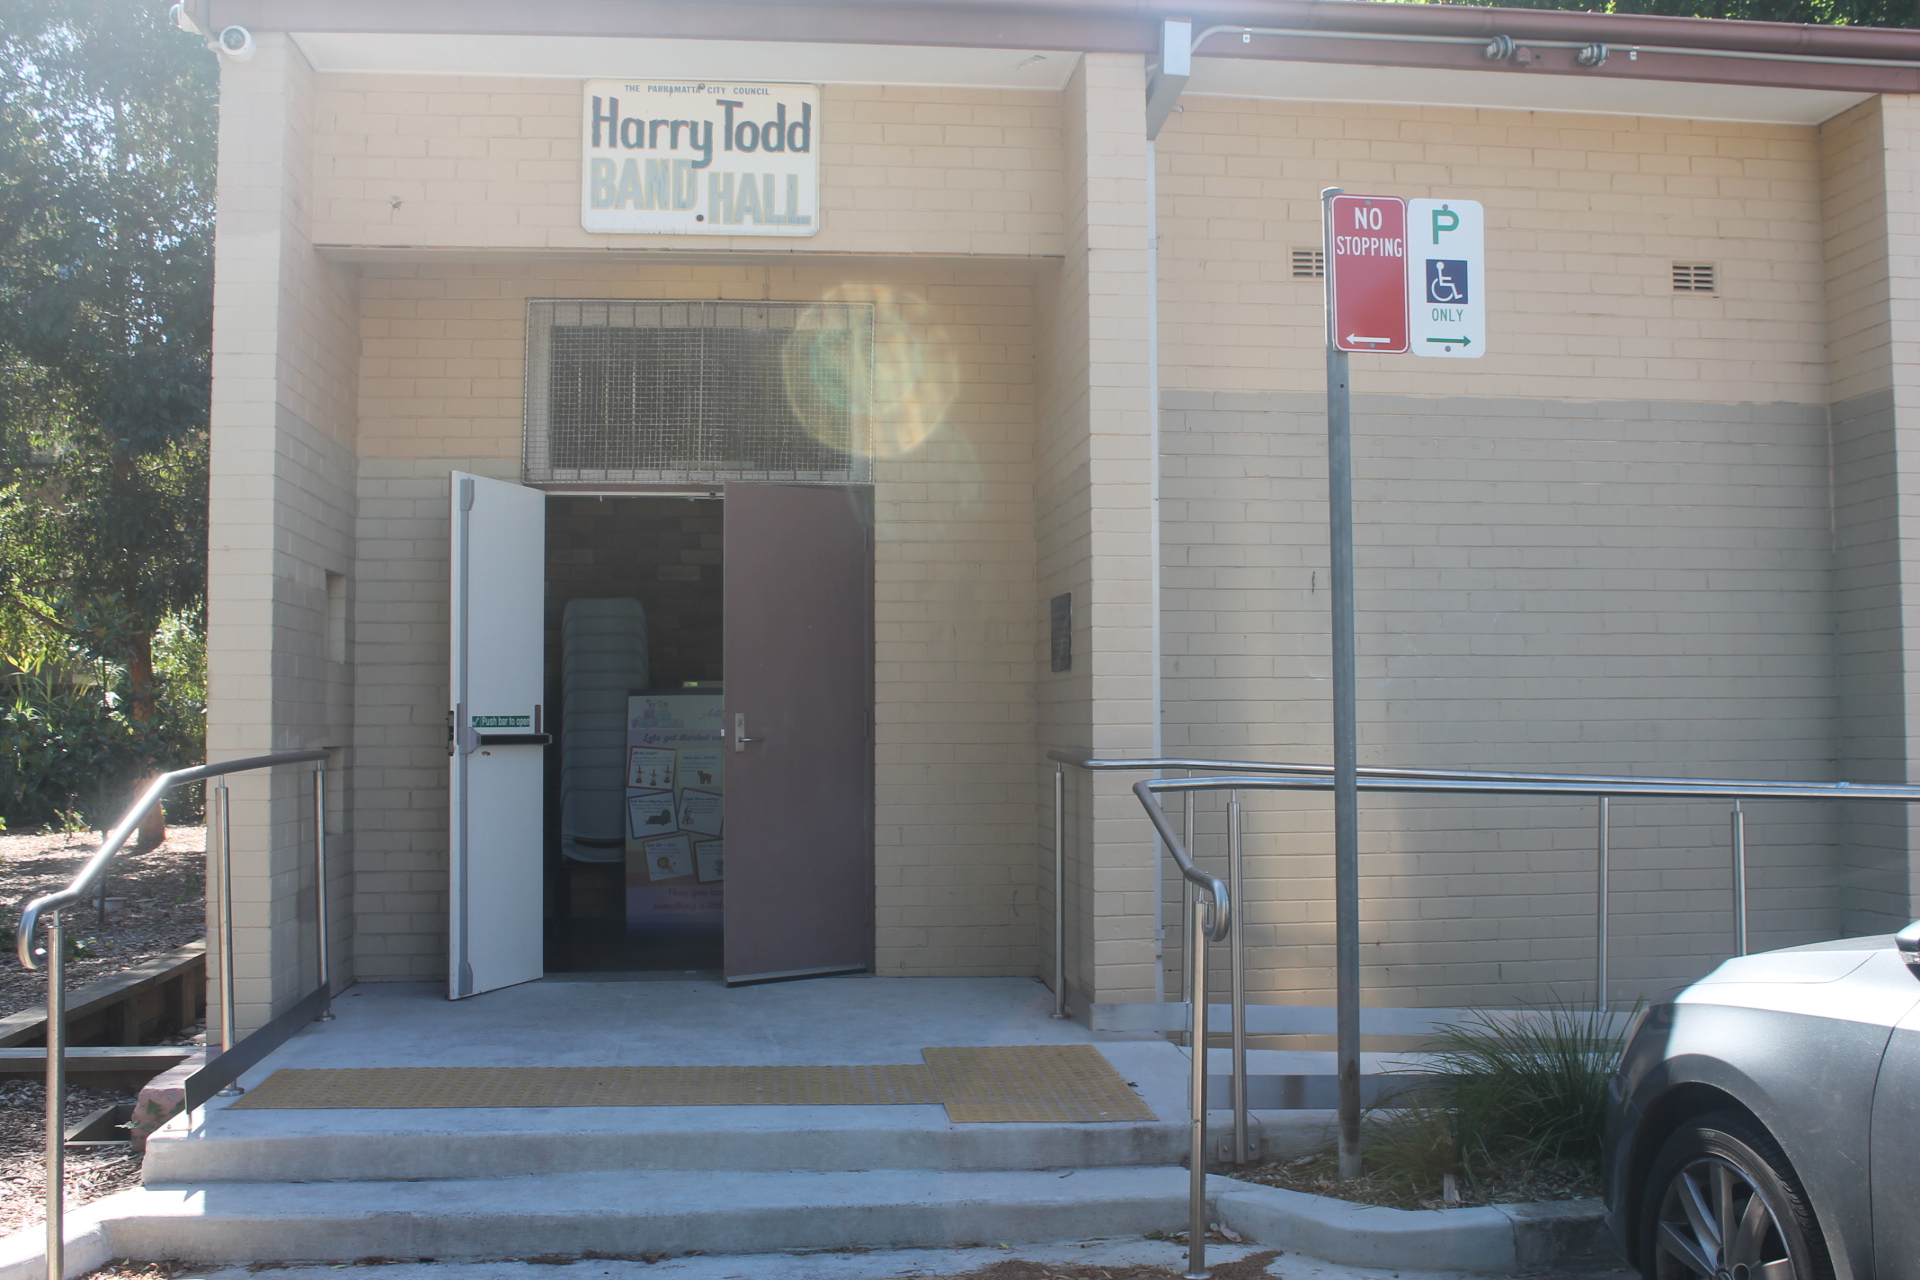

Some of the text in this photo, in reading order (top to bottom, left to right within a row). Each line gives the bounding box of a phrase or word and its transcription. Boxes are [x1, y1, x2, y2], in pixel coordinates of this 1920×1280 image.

[624, 84, 770, 96] THE PARRAMATTA CITY COUNCIL
[591, 95, 812, 170] Harry Todd
[590, 156, 699, 211] BAND
[707, 171, 812, 227] HALL
[1354, 207, 1383, 231] NO
[1432, 209, 1460, 245] P
[1336, 235, 1403, 258] STOPPING
[1431, 307, 1464, 323] ONLY
[481, 717, 497, 726] Push
[498, 717, 508, 726] bar
[509, 717, 515, 726] to
[663, 733, 677, 744] get
[691, 889, 708, 899] you
[653, 900, 696, 912] something
